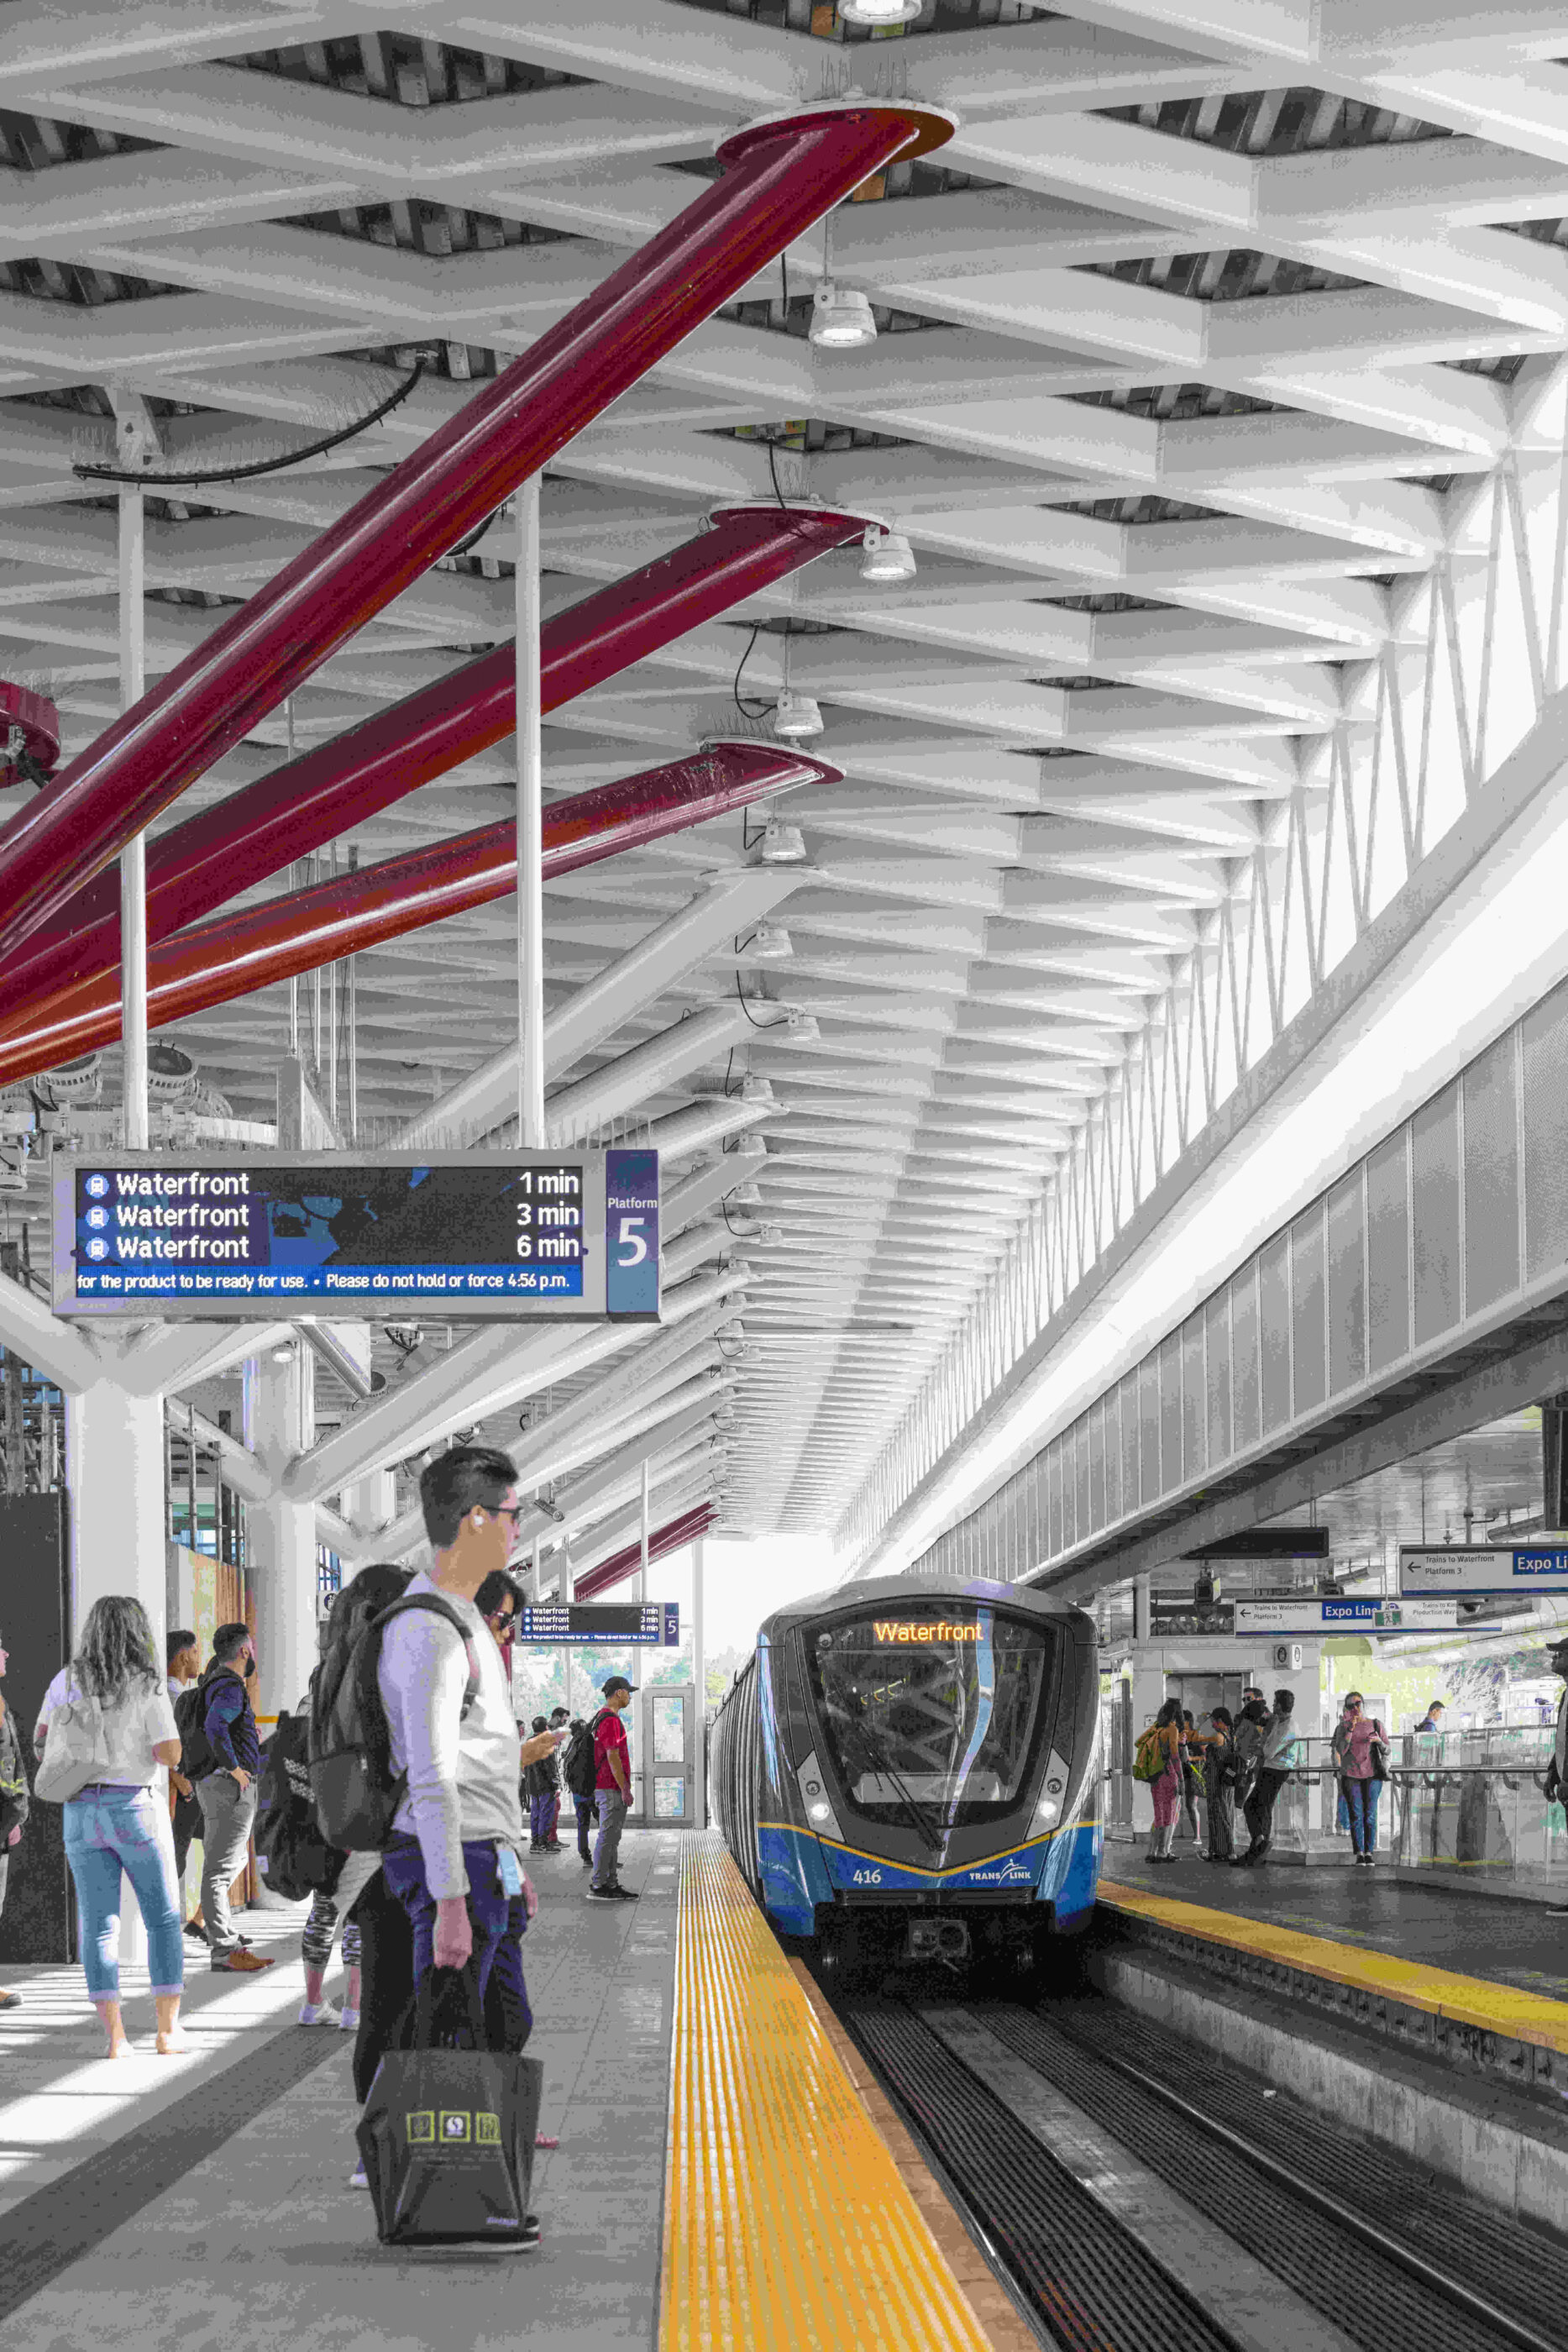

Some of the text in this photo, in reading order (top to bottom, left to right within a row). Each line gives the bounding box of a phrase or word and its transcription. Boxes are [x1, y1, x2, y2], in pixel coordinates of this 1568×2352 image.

[116, 1168, 579, 1194] Waterfront 1 min
[607, 1197, 658, 1209] Platform
[116, 1200, 579, 1226] Waterfront 3 min
[116, 1232, 579, 1258] Waterfront 6 min
[617, 1217, 648, 1267] 5
[77, 1273, 570, 1292] for the product to be ready for use. Please do not hold or force 4:56 p.m.
[1518, 1557, 1552, 1572] Expo
[1325, 1606, 1352, 1619] Expo
[668, 1620, 677, 1634] 5
[874, 1622, 984, 1641] Waterfront
[852, 1869, 881, 1884] 416
[969, 1872, 1001, 1881] TRANS
